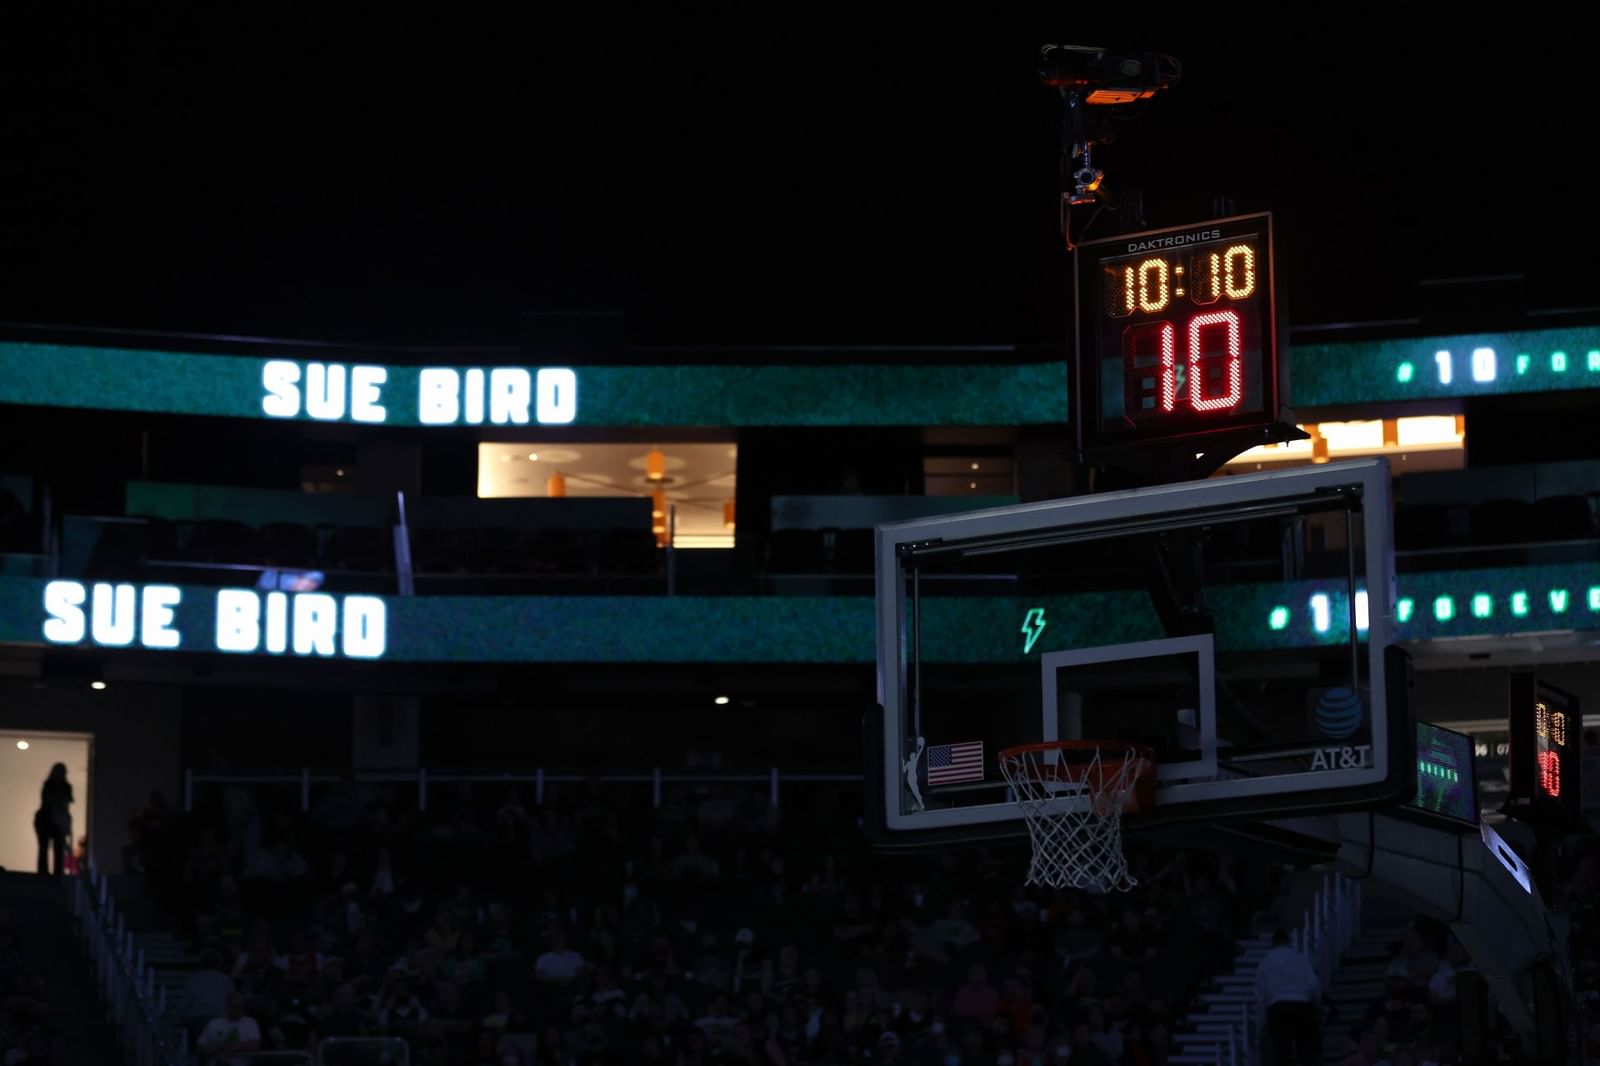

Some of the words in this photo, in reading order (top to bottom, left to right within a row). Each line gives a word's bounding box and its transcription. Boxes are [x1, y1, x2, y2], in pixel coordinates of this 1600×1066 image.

[1127, 229, 1221, 253] DAKTRONICS
[262, 360, 388, 423] SUE
[418, 367, 577, 425] BIRD
[1162, 311, 1241, 412] 10
[43, 580, 181, 649] SUE
[216, 588, 387, 659] BIRD
[1311, 745, 1370, 770] AT&T
